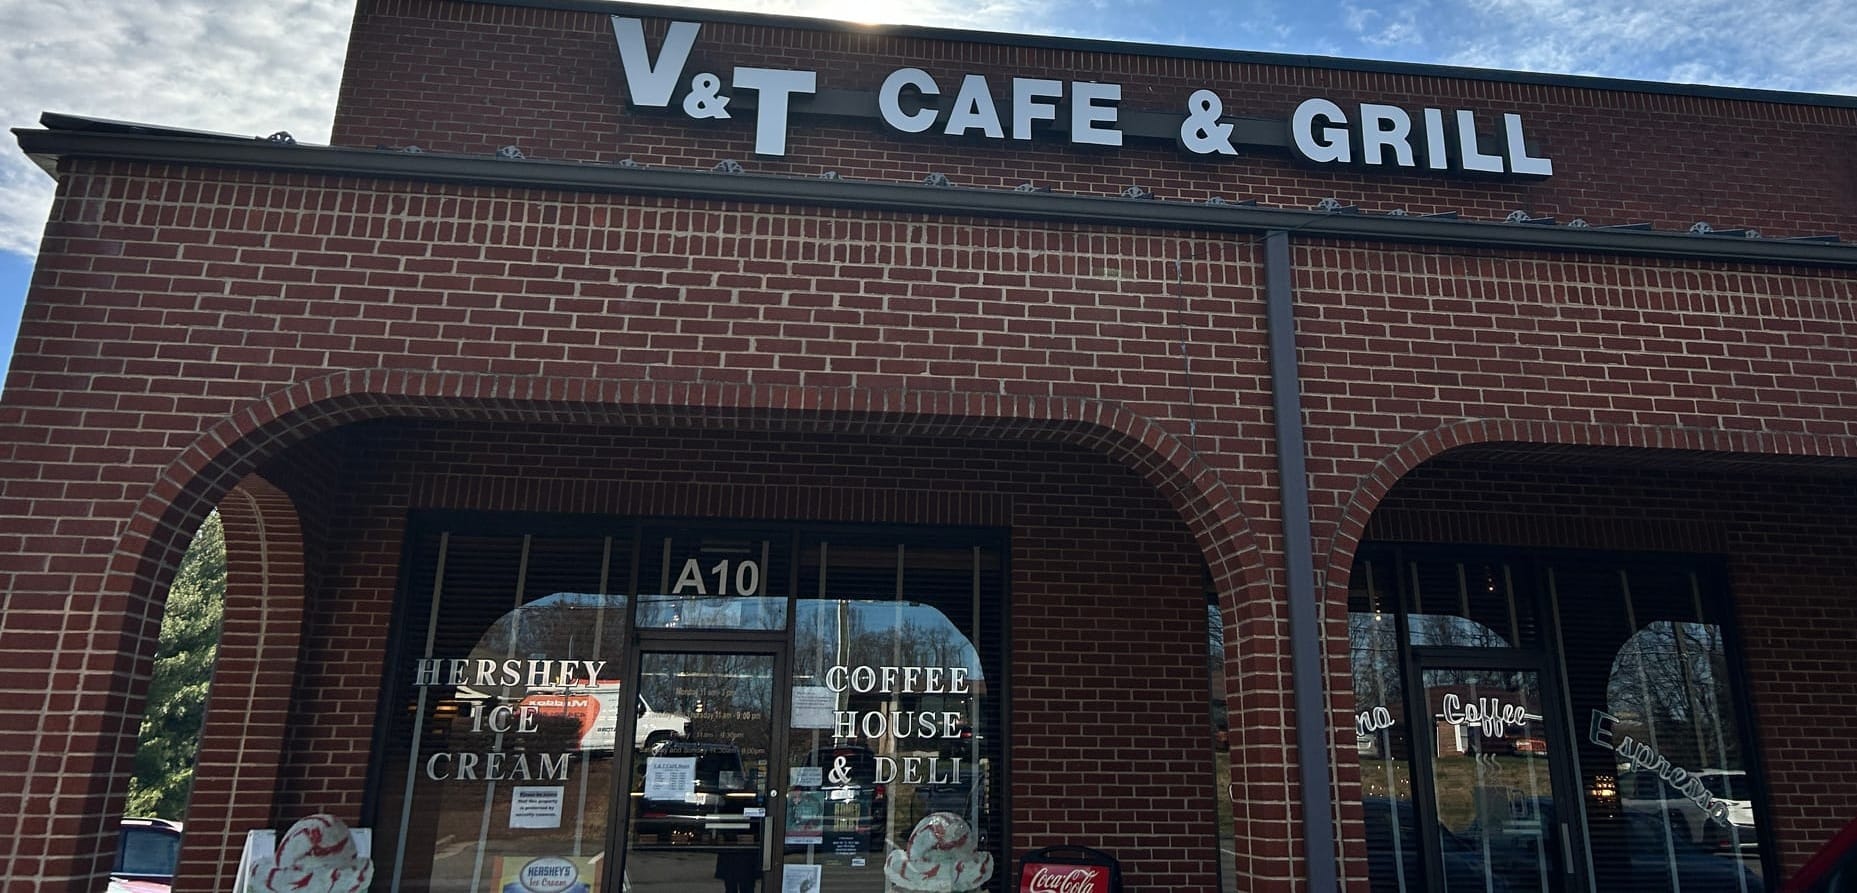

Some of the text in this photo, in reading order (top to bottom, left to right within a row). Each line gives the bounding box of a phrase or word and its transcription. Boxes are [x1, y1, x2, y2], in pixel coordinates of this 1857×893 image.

[879, 67, 1123, 147] CAFE
[1180, 88, 1238, 155] &
[1292, 98, 1553, 178] GRILL
[672, 558, 760, 597] A10
[413, 658, 607, 689] HERSHEY
[825, 665, 970, 695] COFFEE
[471, 705, 539, 733] ICE
[832, 711, 963, 739] HOUSE
[1443, 693, 1527, 738] Coffee
[426, 752, 572, 781] CREAM
[828, 755, 852, 785] &
[873, 757, 963, 785] DELI
[1590, 708, 1729, 827] Espresso
[1030, 867, 1099, 893] Coca-Cola
